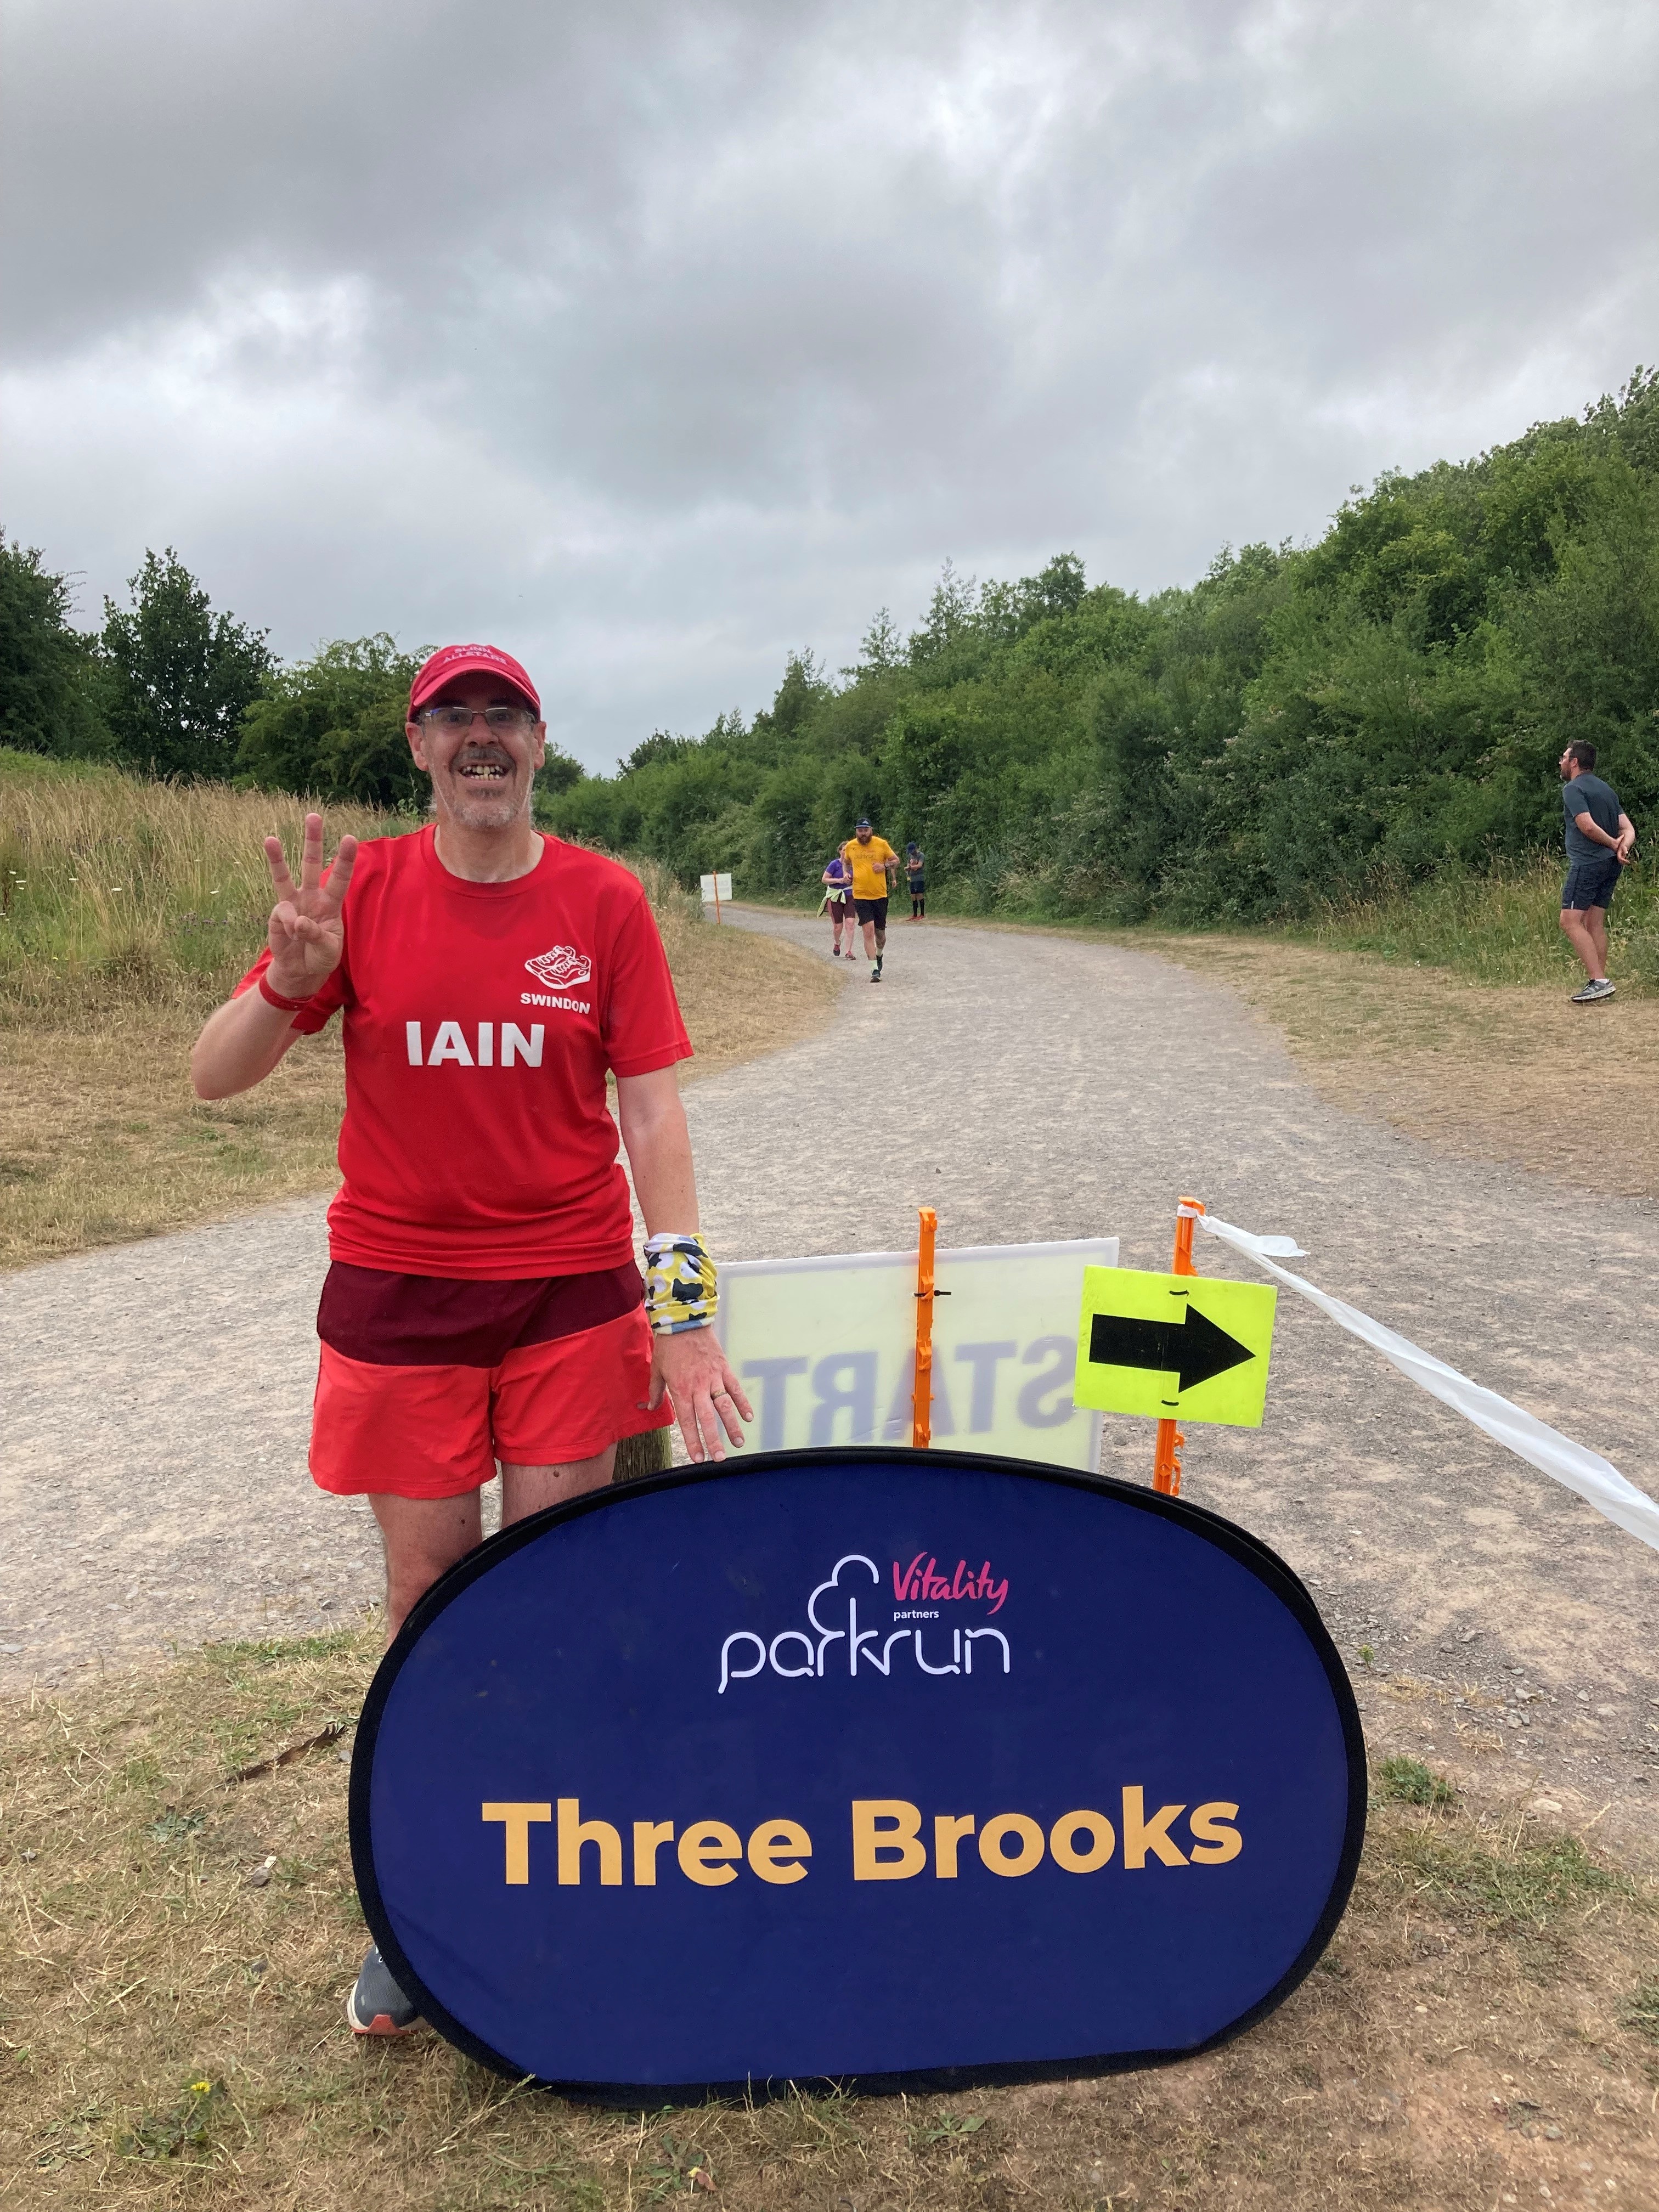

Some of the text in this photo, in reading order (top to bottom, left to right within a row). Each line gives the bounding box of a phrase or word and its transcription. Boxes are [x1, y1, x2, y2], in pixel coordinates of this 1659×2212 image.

[443, 651, 508, 665] ALLSTARS
[520, 992, 590, 1014] SWINDON
[406, 1021, 545, 1067] IAIN
[893, 1551, 1009, 1615] Vitality
[893, 1610, 939, 1622] partners
[718, 1597, 1010, 1694] parkrun
[482, 1785, 1243, 1886] Three Brooks
